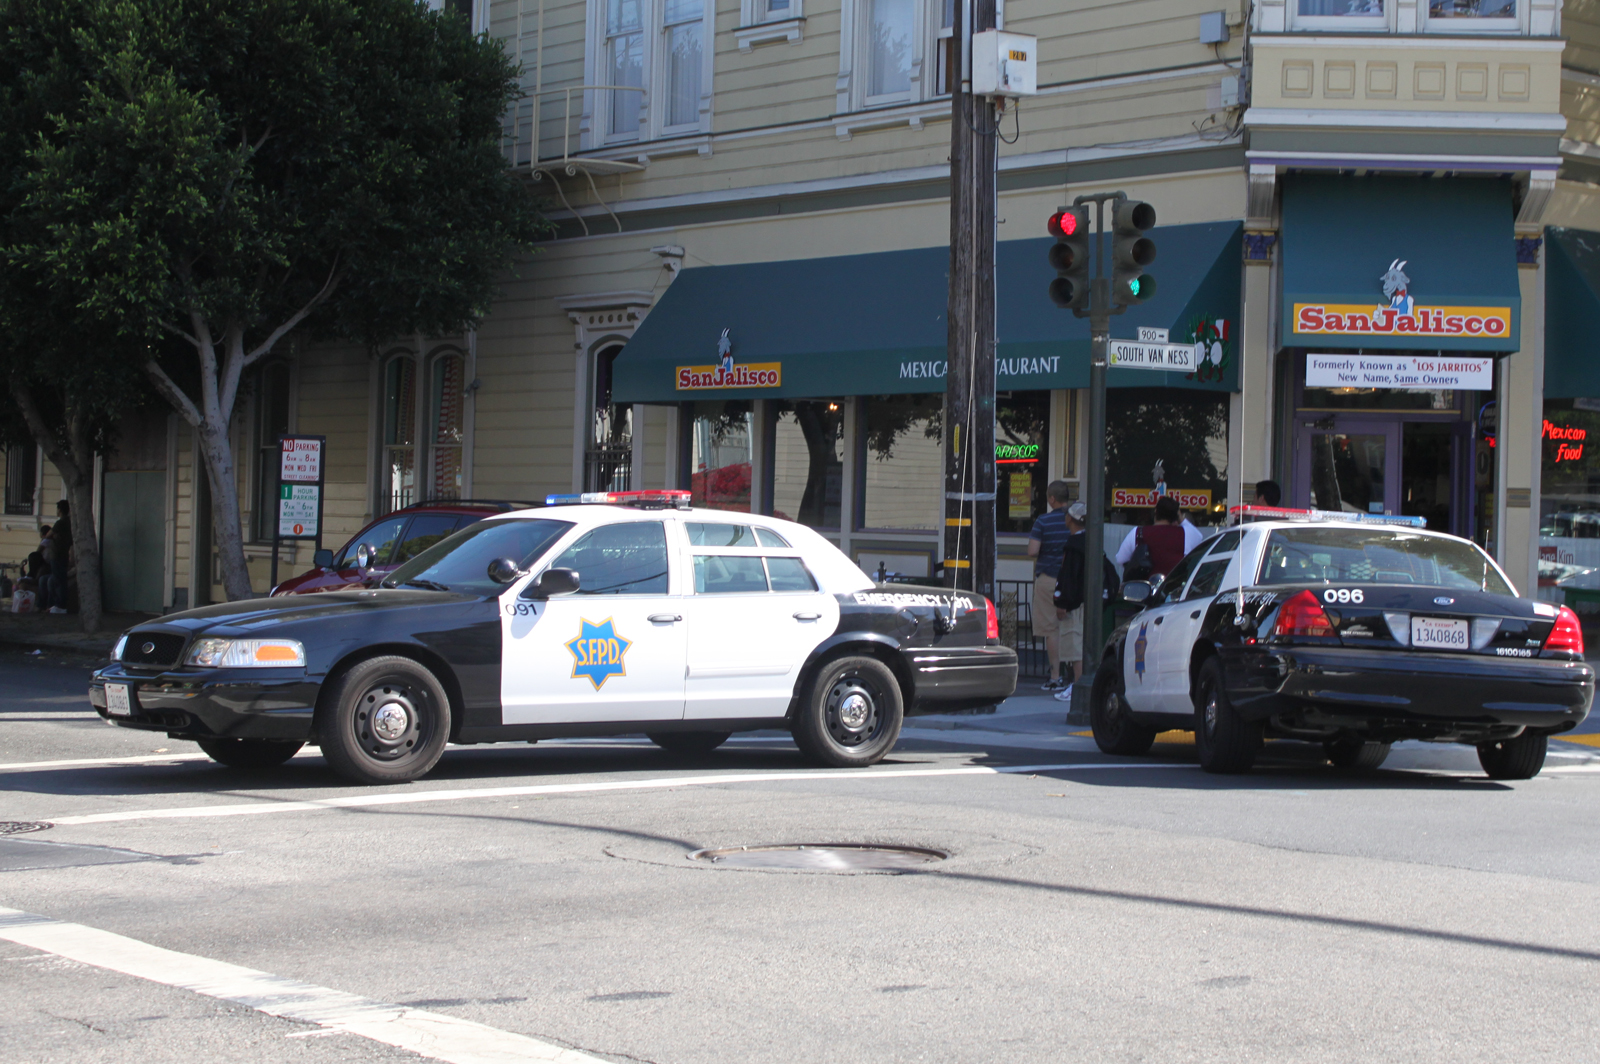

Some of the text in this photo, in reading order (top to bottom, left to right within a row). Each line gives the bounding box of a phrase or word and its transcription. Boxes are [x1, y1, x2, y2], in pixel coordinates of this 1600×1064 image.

[1299, 306, 1505, 335] SanJalisco
[1141, 330, 1156, 340] 900
[1117, 346, 1143, 362] SOUTH
[1148, 348, 1163, 363] VAN
[1168, 350, 1188, 365] NESS
[900, 356, 1060, 378] MEXICA TAURANT
[1313, 359, 1355, 372] Formerly
[1360, 361, 1393, 370] Known
[1396, 363, 1407, 371] as
[679, 366, 778, 389] SanJalisco
[1338, 373, 1459, 384] New Name, Same Owners
[1541, 419, 1587, 440] Mexican
[283, 440, 319, 452] NO PARKING
[995, 444, 1039, 458] ARISCOS
[284, 487, 288, 498] 1
[1114, 489, 1209, 507] SanJlisco
[1558, 549, 1574, 565] Kim
[853, 592, 942, 607] EMERGENCY
[1323, 589, 1364, 604] 096
[505, 603, 537, 616] 091
[1416, 628, 1465, 644] 1340868
